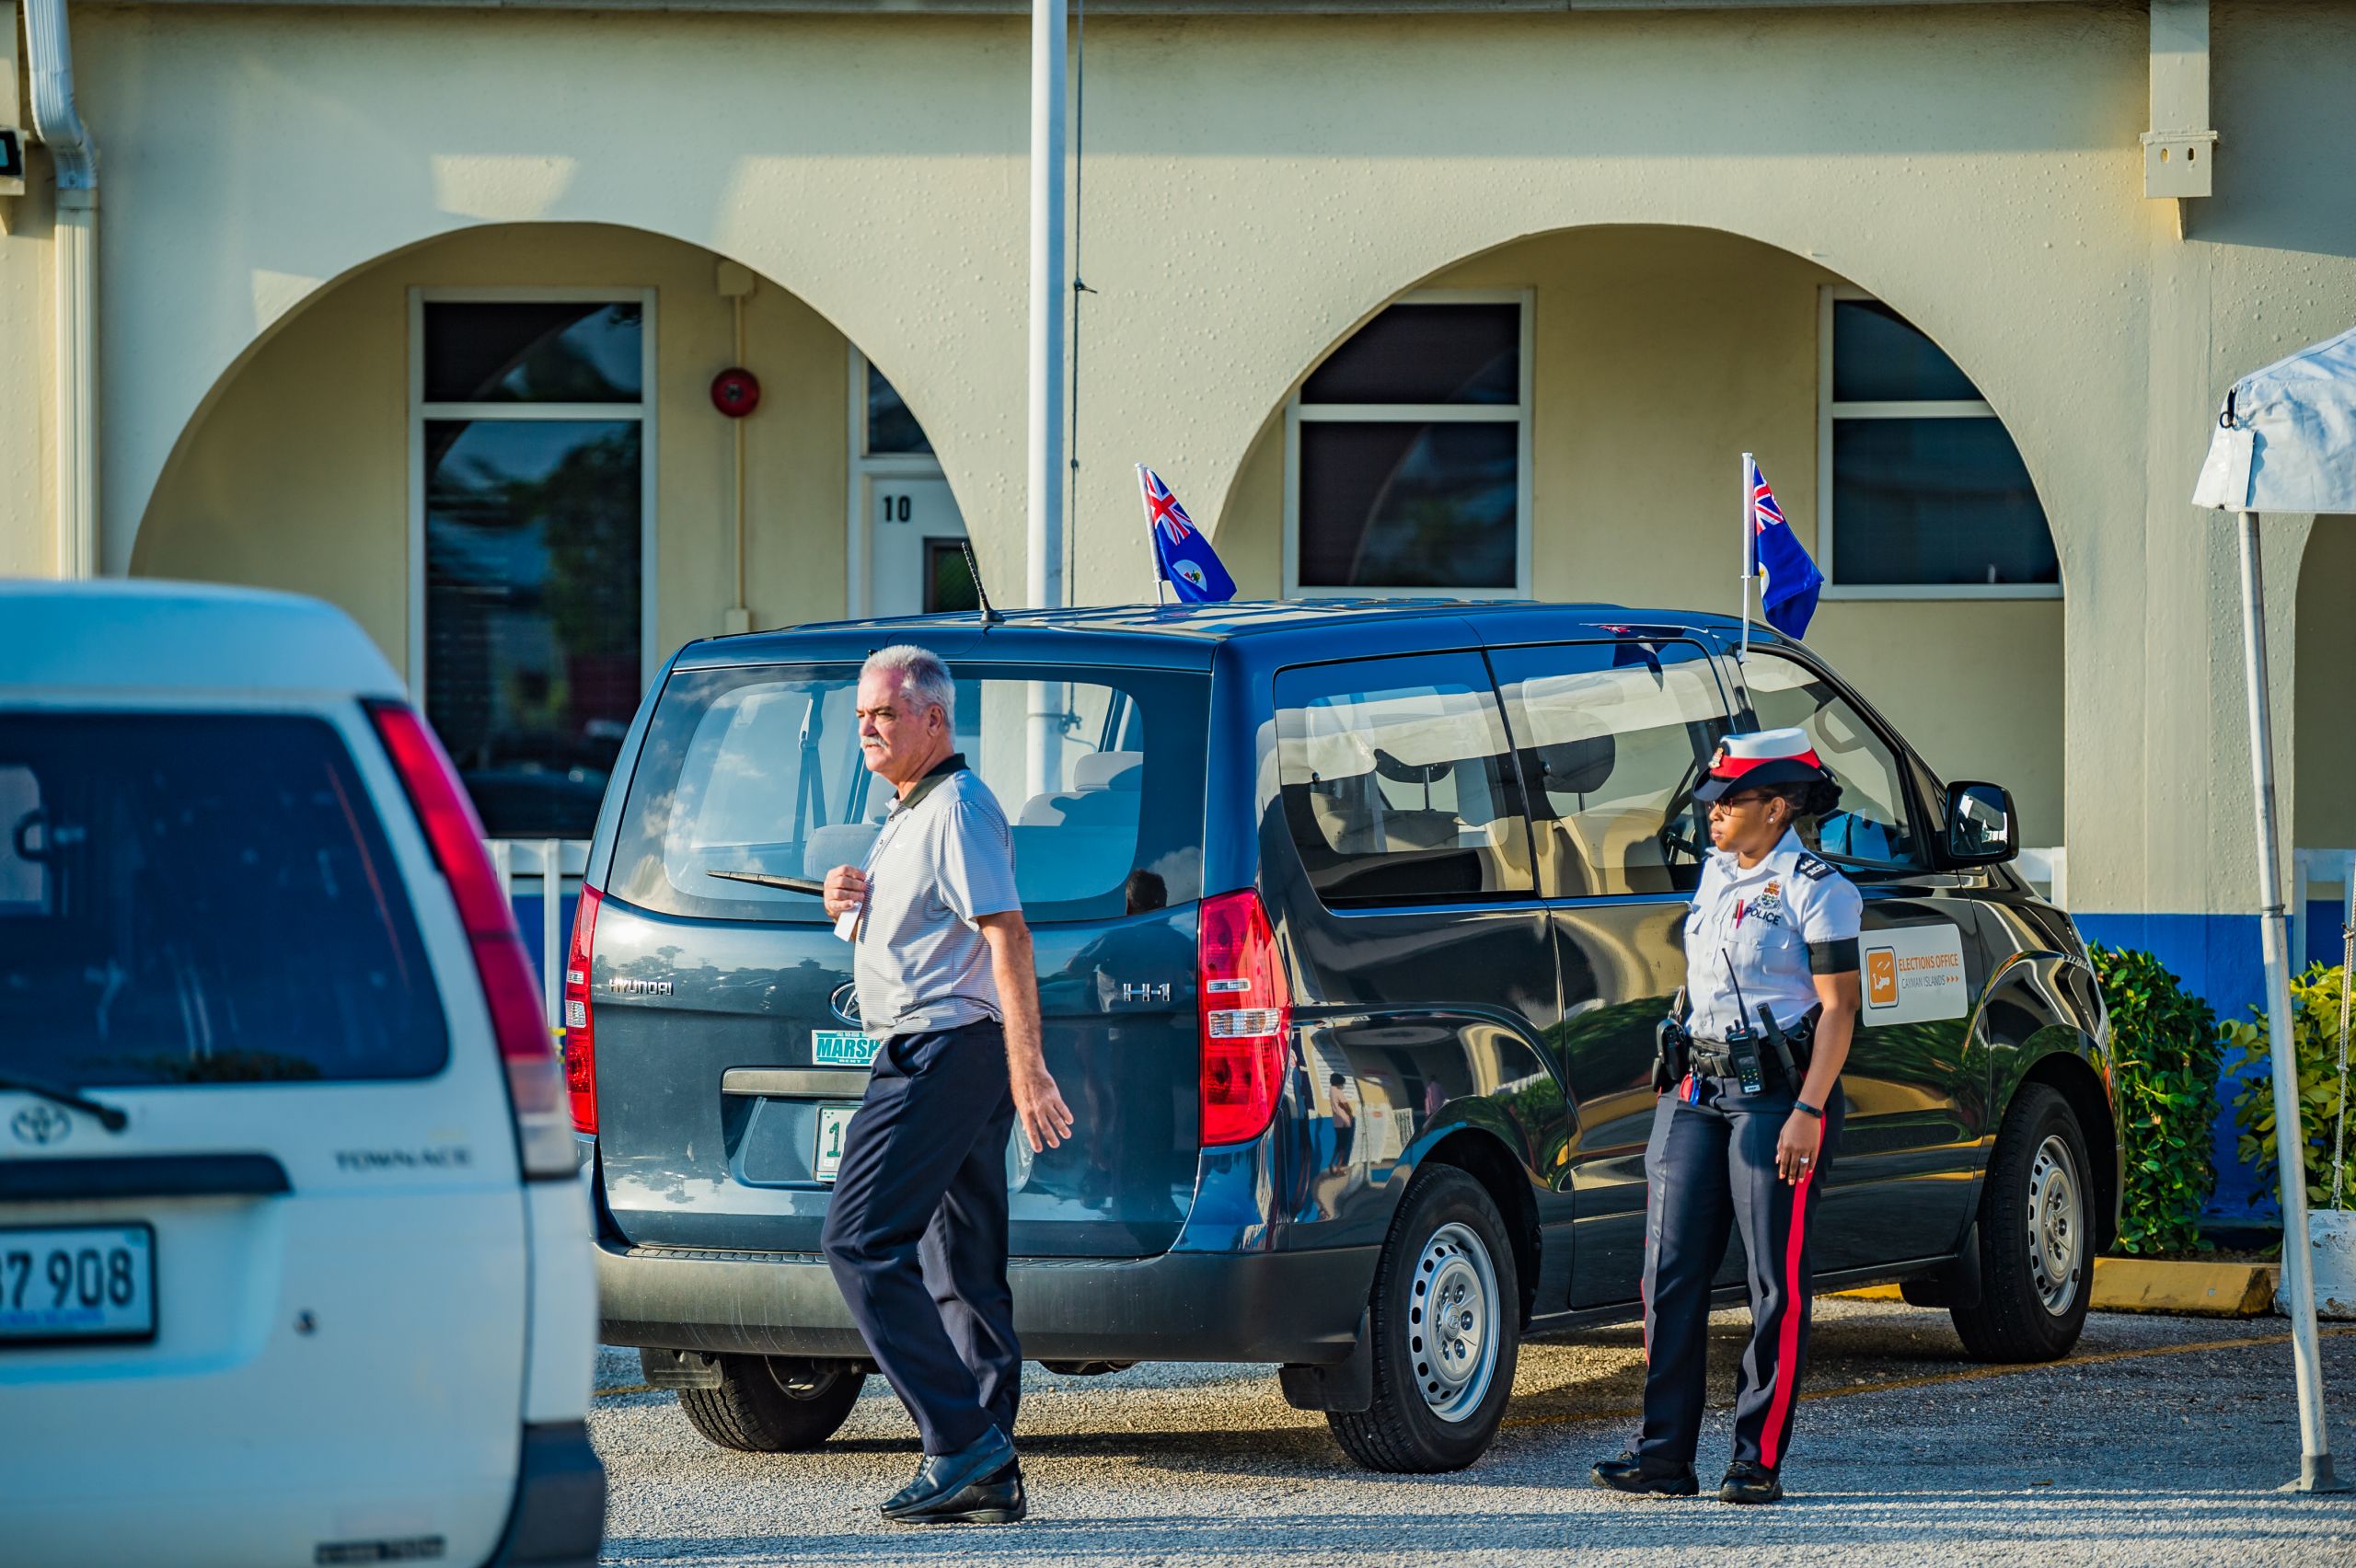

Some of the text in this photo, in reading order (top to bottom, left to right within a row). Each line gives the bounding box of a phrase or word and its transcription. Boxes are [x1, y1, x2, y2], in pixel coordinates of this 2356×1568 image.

[883, 495, 911, 523] 10
[1743, 906, 1782, 926] POLICE
[1899, 953, 1959, 972] ELECTIONS OFFICE
[608, 977, 674, 996] HYUNDAI
[1901, 974, 1946, 989] CAYMAN ISLANDS
[1123, 983, 1171, 1002] H-1
[0, 1247, 134, 1310] 7 908
